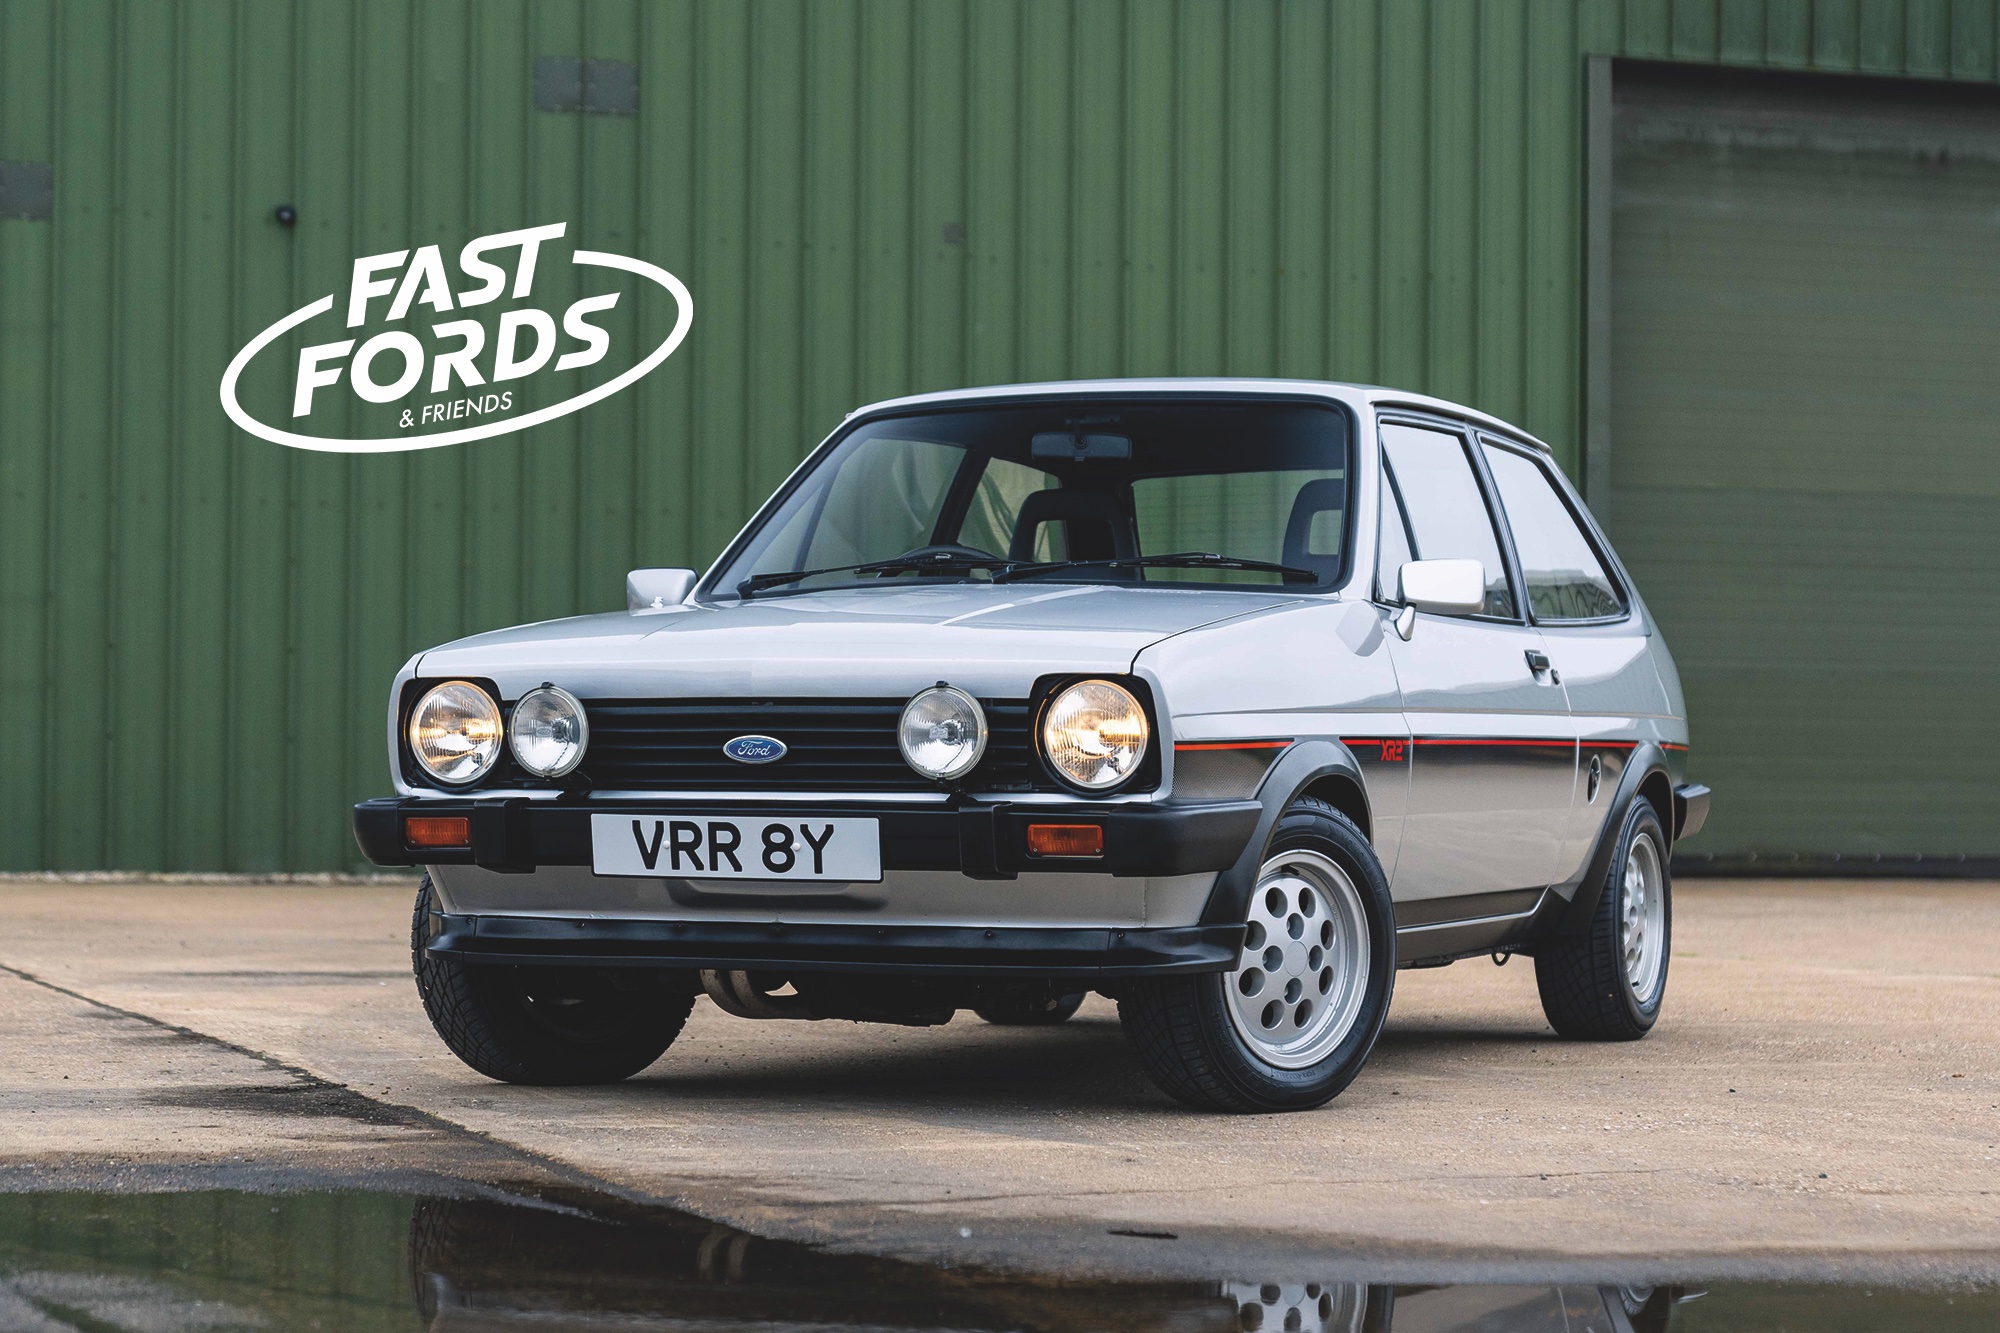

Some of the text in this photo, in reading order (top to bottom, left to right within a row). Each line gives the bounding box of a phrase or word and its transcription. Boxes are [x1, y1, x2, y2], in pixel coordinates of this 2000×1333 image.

[738, 740, 771, 755] Ford
[1381, 740, 1403, 762] XR2
[632, 820, 834, 874] VRR 8Y
